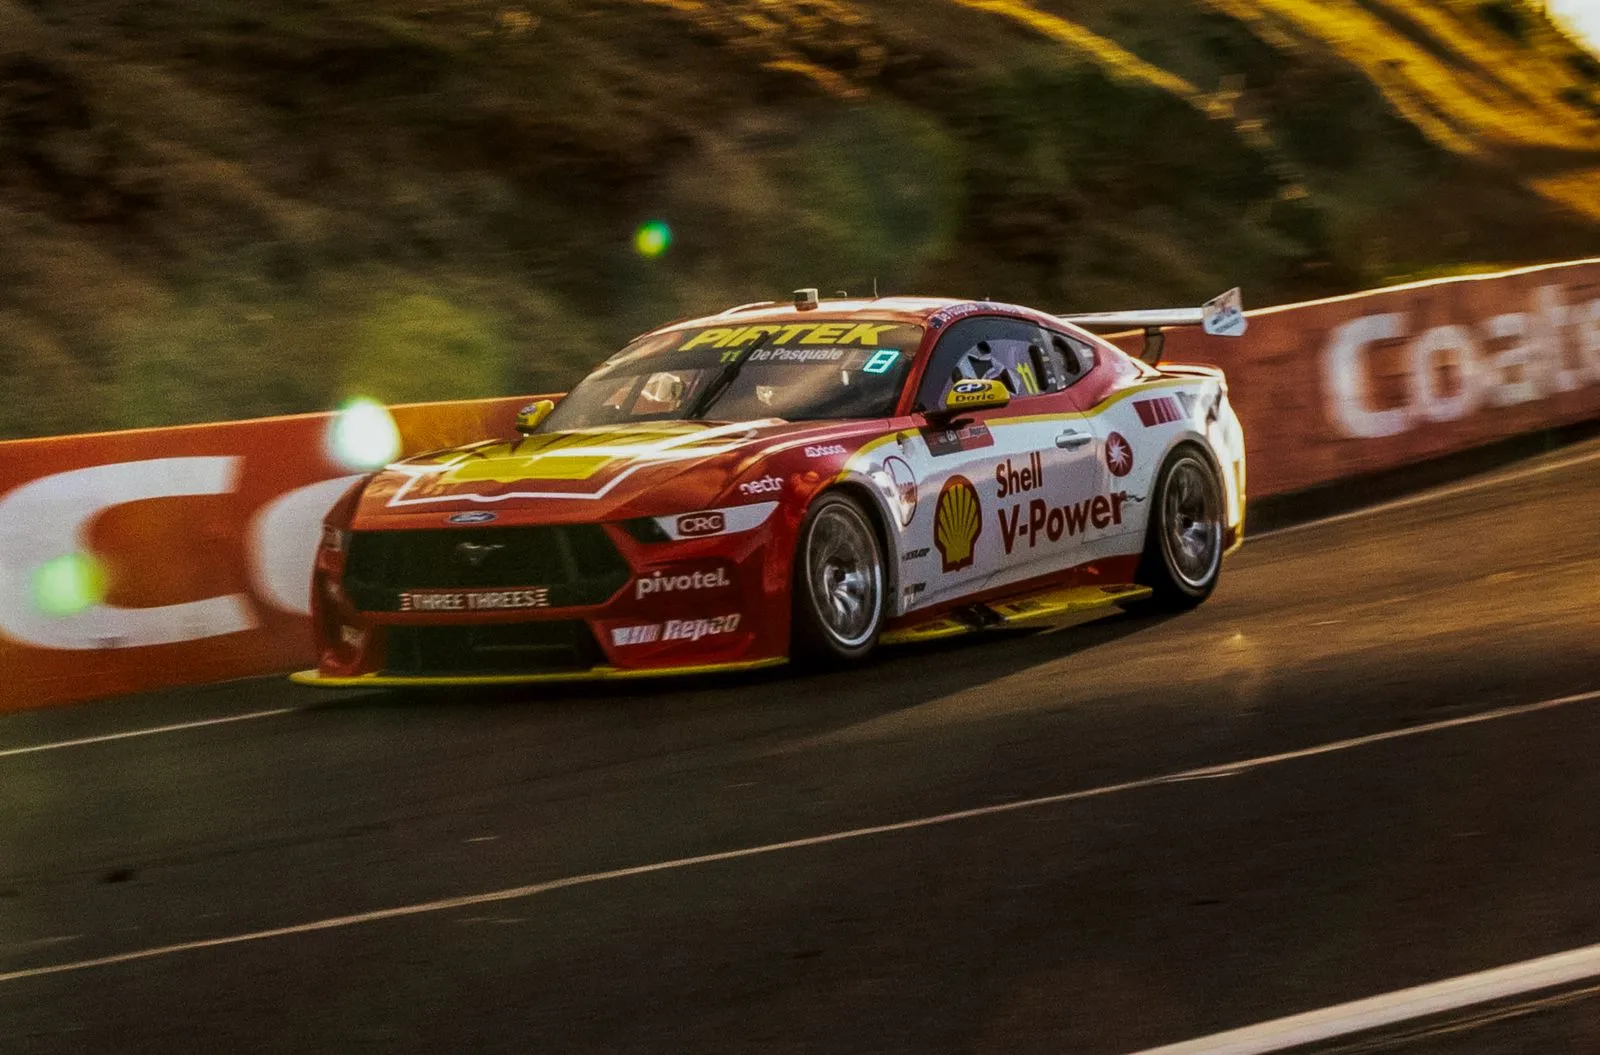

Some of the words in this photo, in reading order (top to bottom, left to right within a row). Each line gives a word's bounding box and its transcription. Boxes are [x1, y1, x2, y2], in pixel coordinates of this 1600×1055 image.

[678, 323, 899, 352] PIRTEK
[769, 347, 844, 363] Pasquale
[955, 391, 996, 402] Doric
[996, 450, 1043, 498] Shell
[678, 514, 723, 534] CRC
[998, 490, 1128, 555] V-Power
[411, 593, 465, 610] THREE
[466, 590, 537, 609] THREES
[661, 612, 742, 642] Repco
